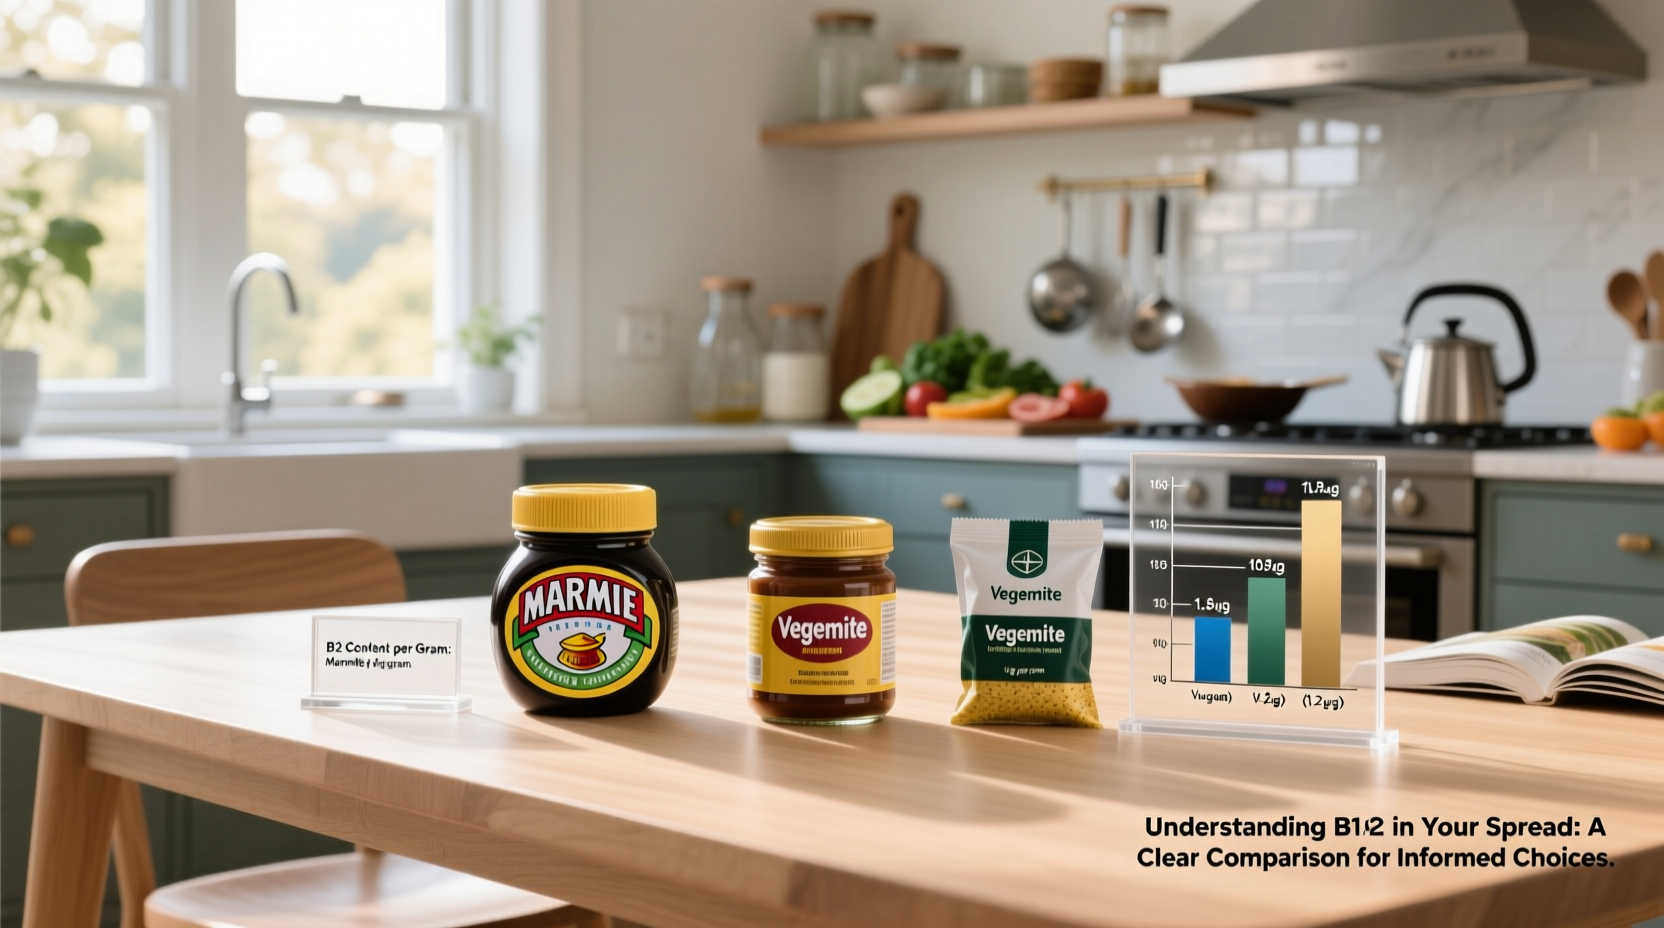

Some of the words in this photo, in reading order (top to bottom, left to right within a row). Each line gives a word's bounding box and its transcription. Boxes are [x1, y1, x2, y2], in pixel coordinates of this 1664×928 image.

[524, 577, 638, 625] MARMIE
[991, 585, 1062, 605] Vegemite
[777, 615, 868, 646] Vegemite
[985, 624, 1066, 647] Vegemite
[326, 641, 343, 653] B2
[393, 644, 413, 657] per
[415, 643, 452, 655] Gram:
